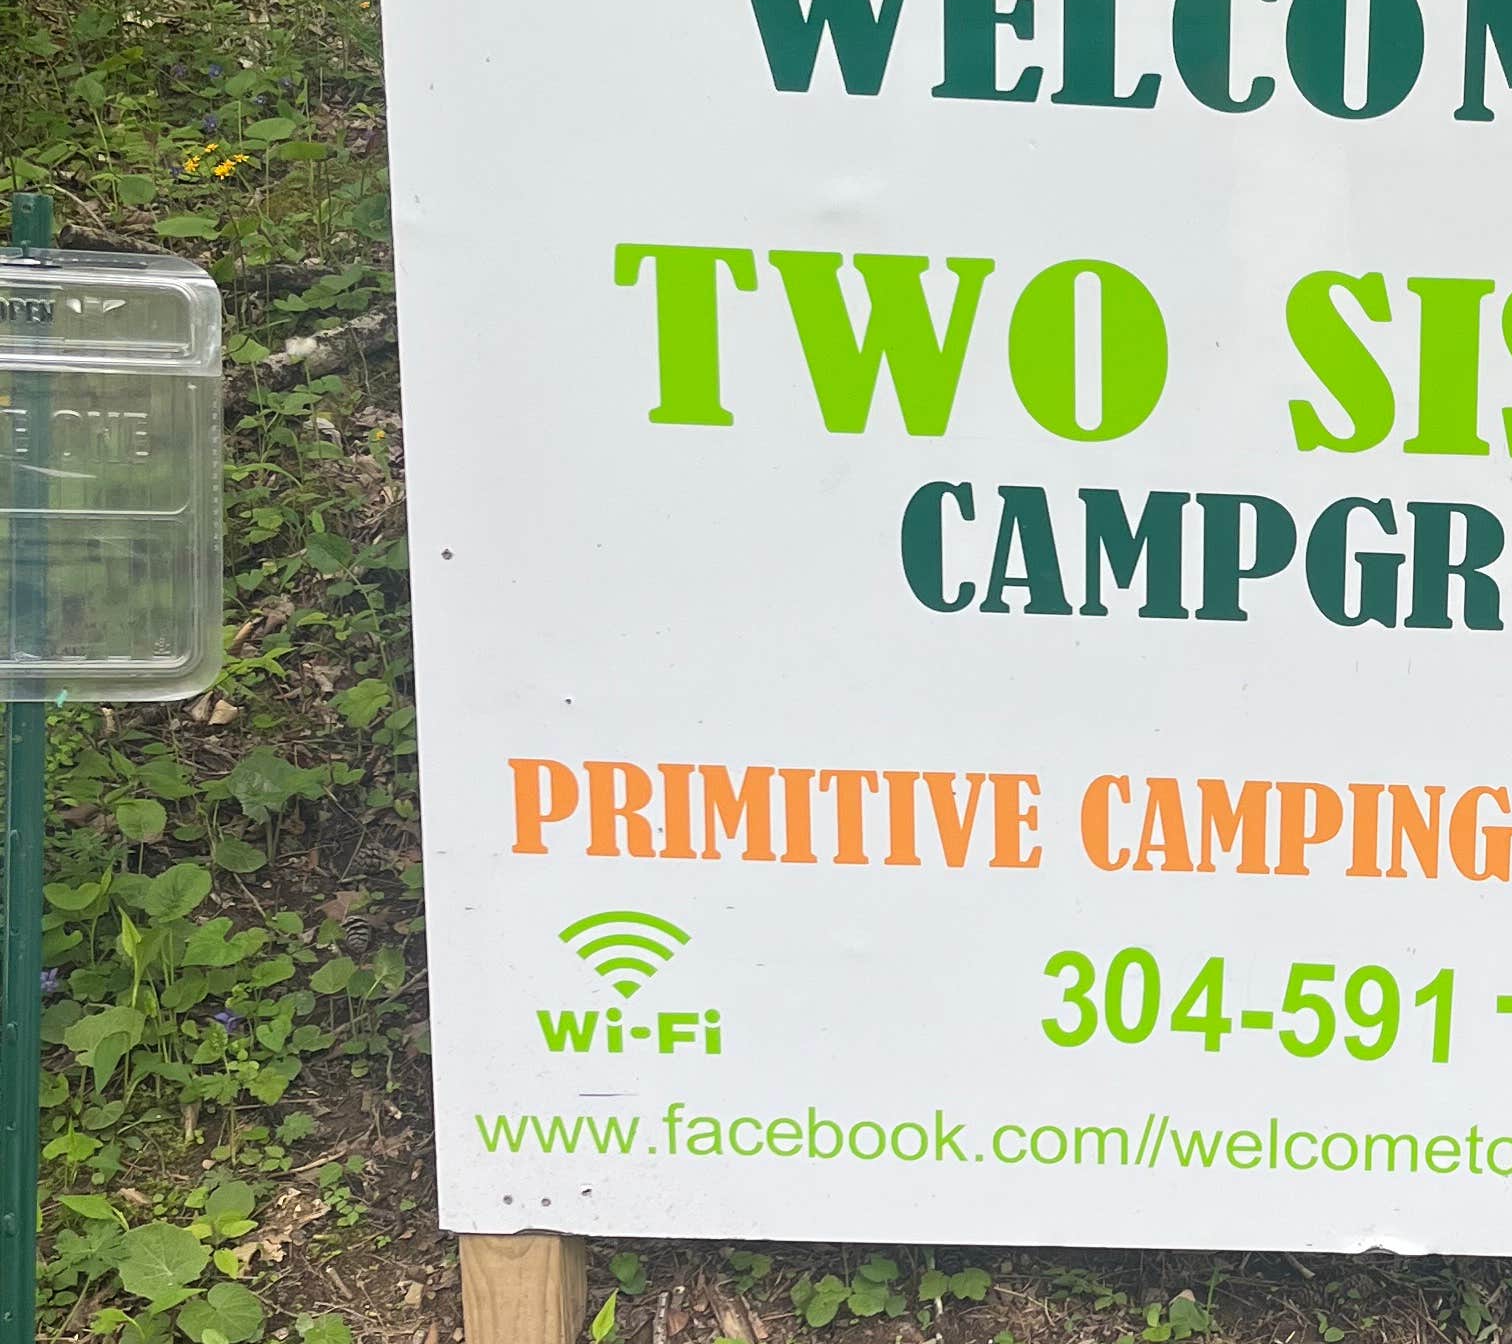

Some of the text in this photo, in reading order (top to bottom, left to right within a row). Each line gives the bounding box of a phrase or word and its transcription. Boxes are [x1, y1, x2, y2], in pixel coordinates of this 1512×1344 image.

[614, 243, 1170, 443] TWO
[508, 758, 1043, 869] PRIMITIVE
[536, 1006, 722, 1056] Wi-Fi
